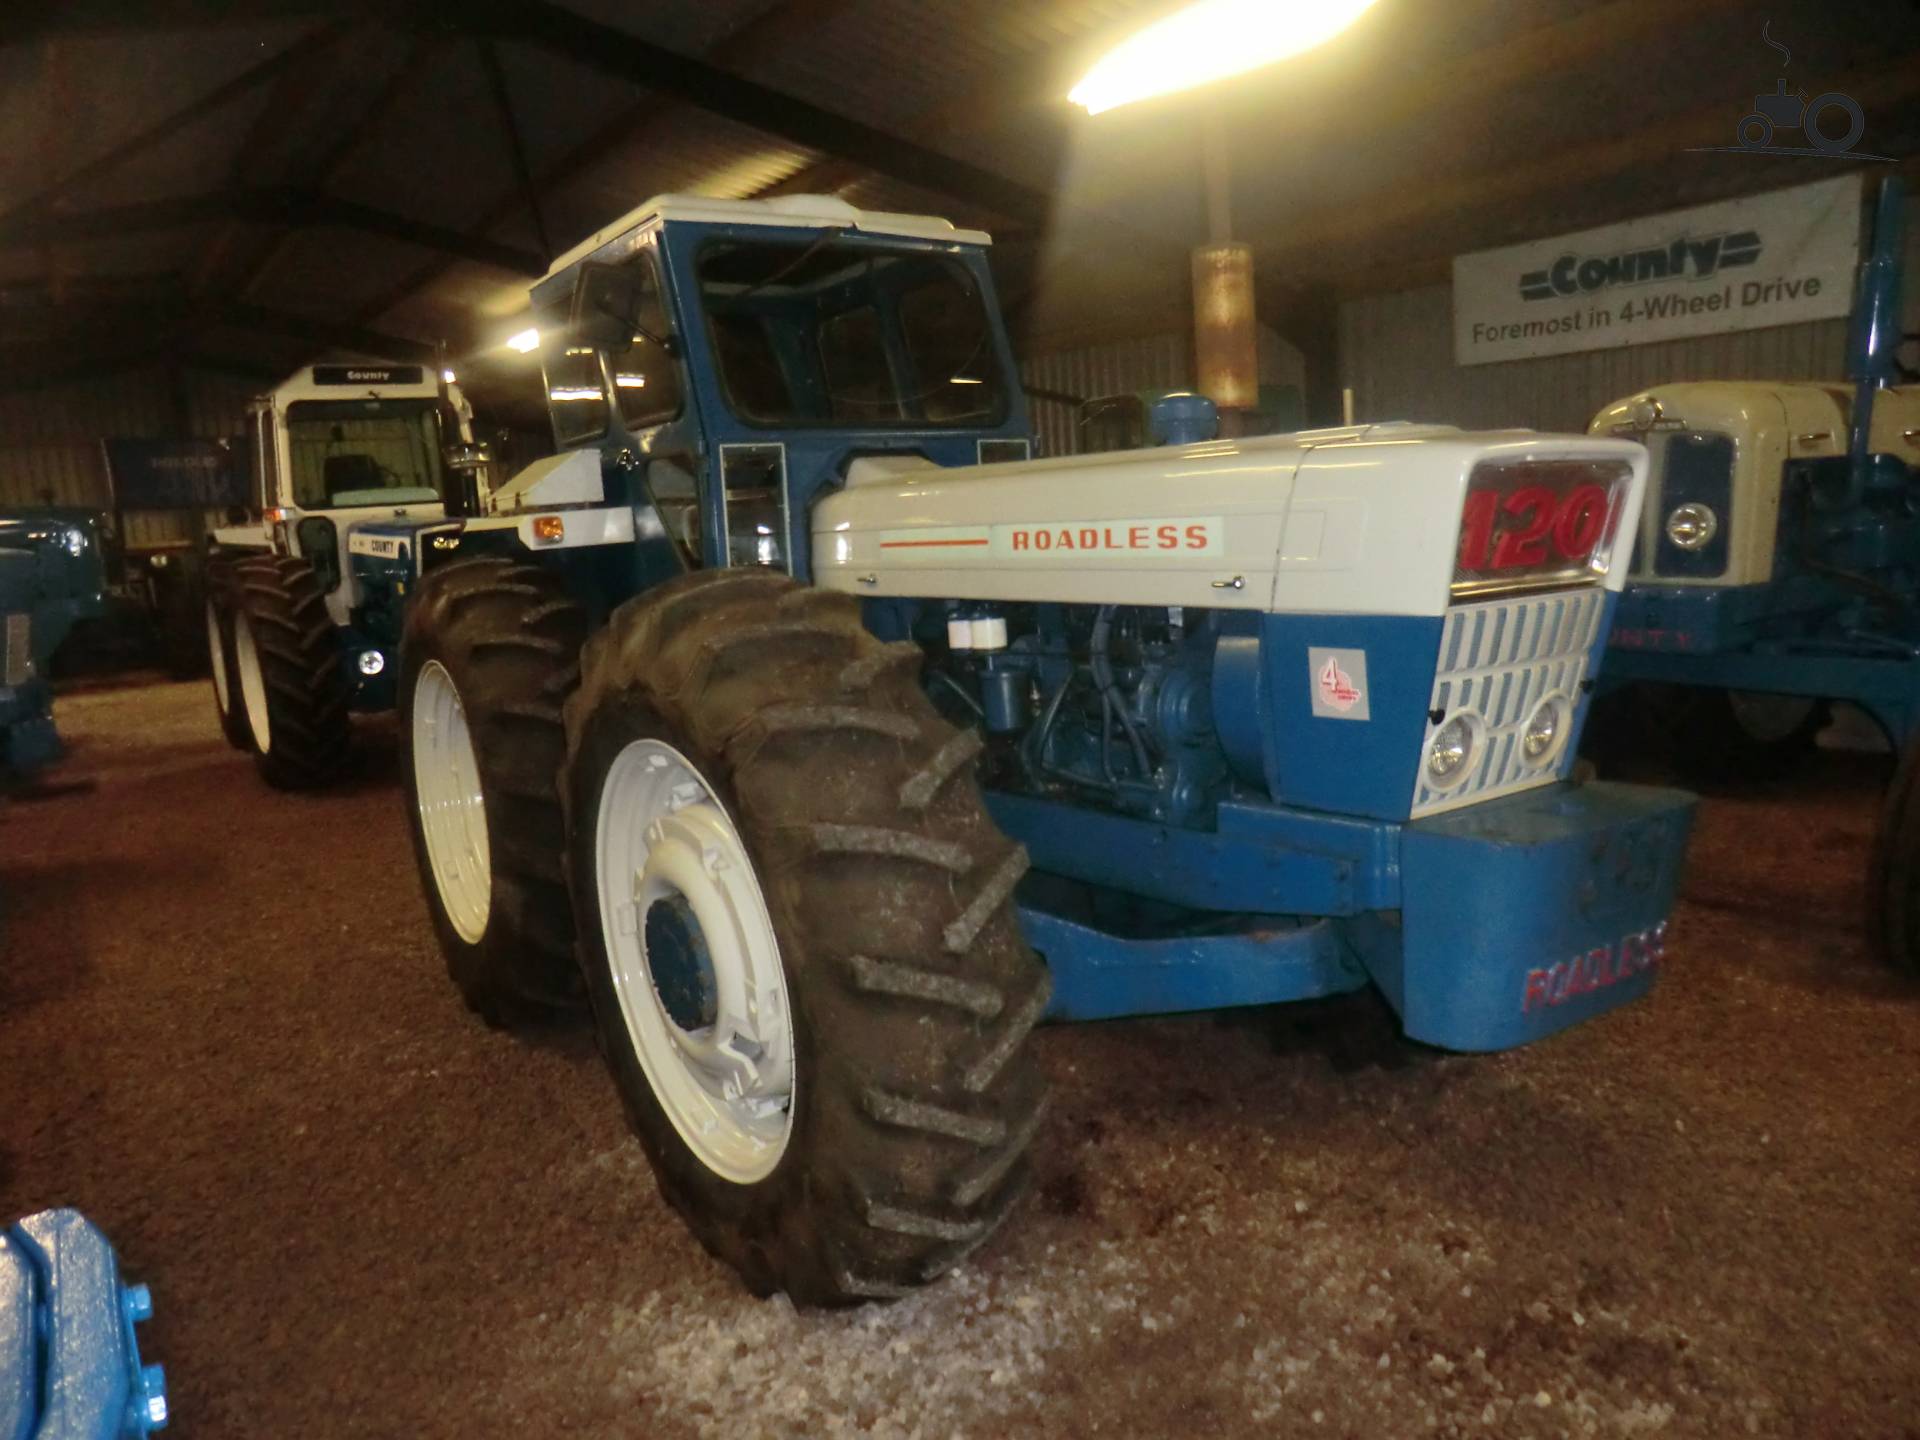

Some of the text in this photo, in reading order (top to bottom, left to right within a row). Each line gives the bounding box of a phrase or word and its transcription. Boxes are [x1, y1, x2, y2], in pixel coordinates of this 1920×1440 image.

[1549, 235, 1723, 294] County
[1472, 273, 1823, 344] Foremost in 4-Wheel Drive
[346, 369, 390, 382] County
[1011, 524, 1209, 552] ROADLESS
[1459, 484, 1609, 569] 120
